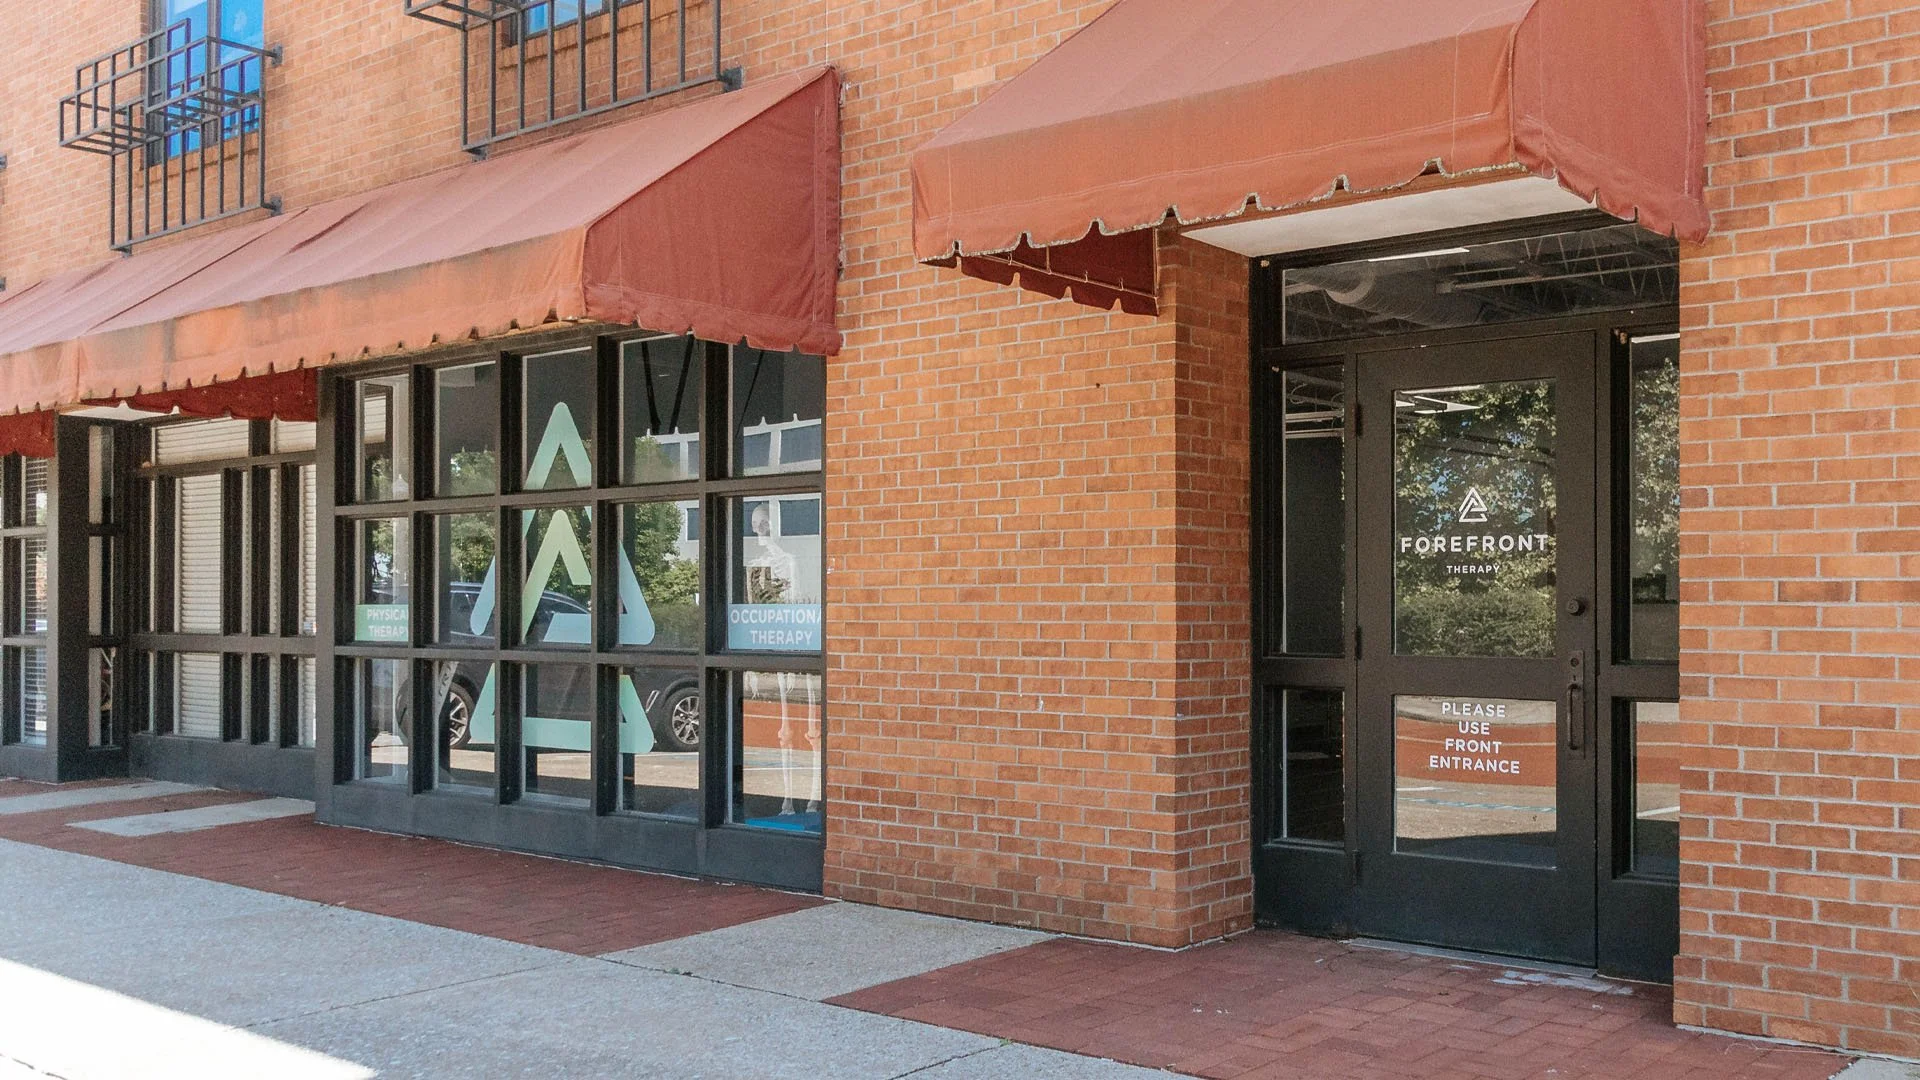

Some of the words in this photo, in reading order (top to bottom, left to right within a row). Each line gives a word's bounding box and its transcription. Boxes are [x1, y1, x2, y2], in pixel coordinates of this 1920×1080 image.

[1401, 535, 1549, 553] FOREFRONT
[1446, 565, 1500, 574] THERAPY
[367, 608, 408, 620] PHYSICA
[730, 609, 821, 624] OCCUPATION
[750, 630, 812, 645] THERAPY
[1442, 702, 1506, 717] PLEASE
[1458, 721, 1490, 735] USE
[1445, 738, 1502, 753] FRONT
[1429, 755, 1520, 773] ENTRANCE
